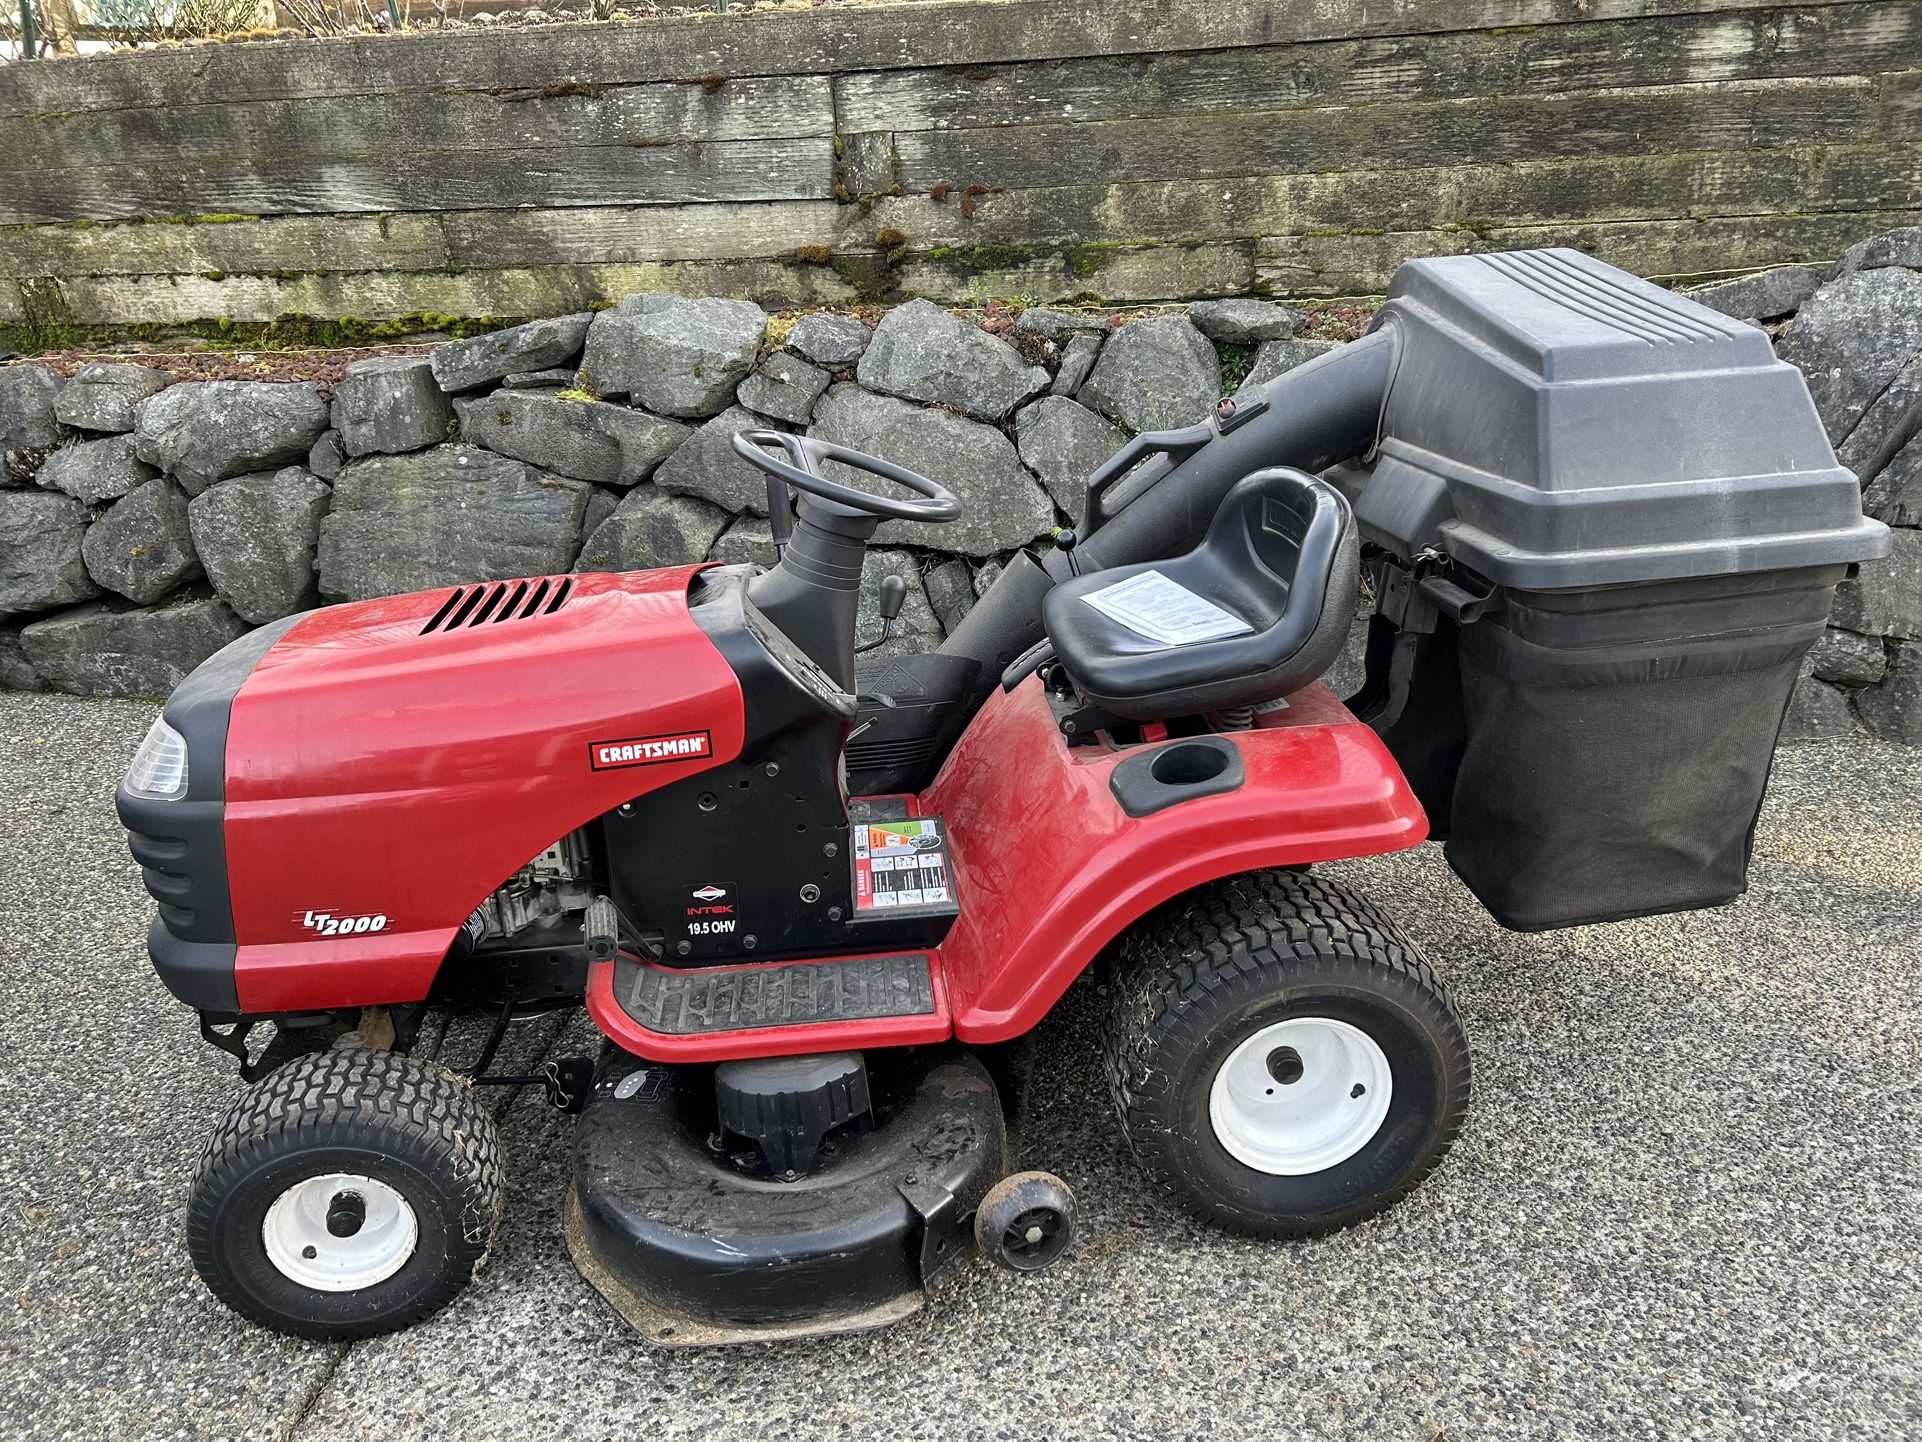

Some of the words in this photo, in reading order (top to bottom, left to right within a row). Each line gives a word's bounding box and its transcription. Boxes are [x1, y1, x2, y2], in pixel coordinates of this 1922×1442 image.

[599, 737, 703, 763] CRAFTSMAN
[687, 904, 735, 916] INTEK
[303, 910, 387, 935] LT2000
[687, 922, 710, 935] 19.5
[711, 919, 736, 933] OHV
